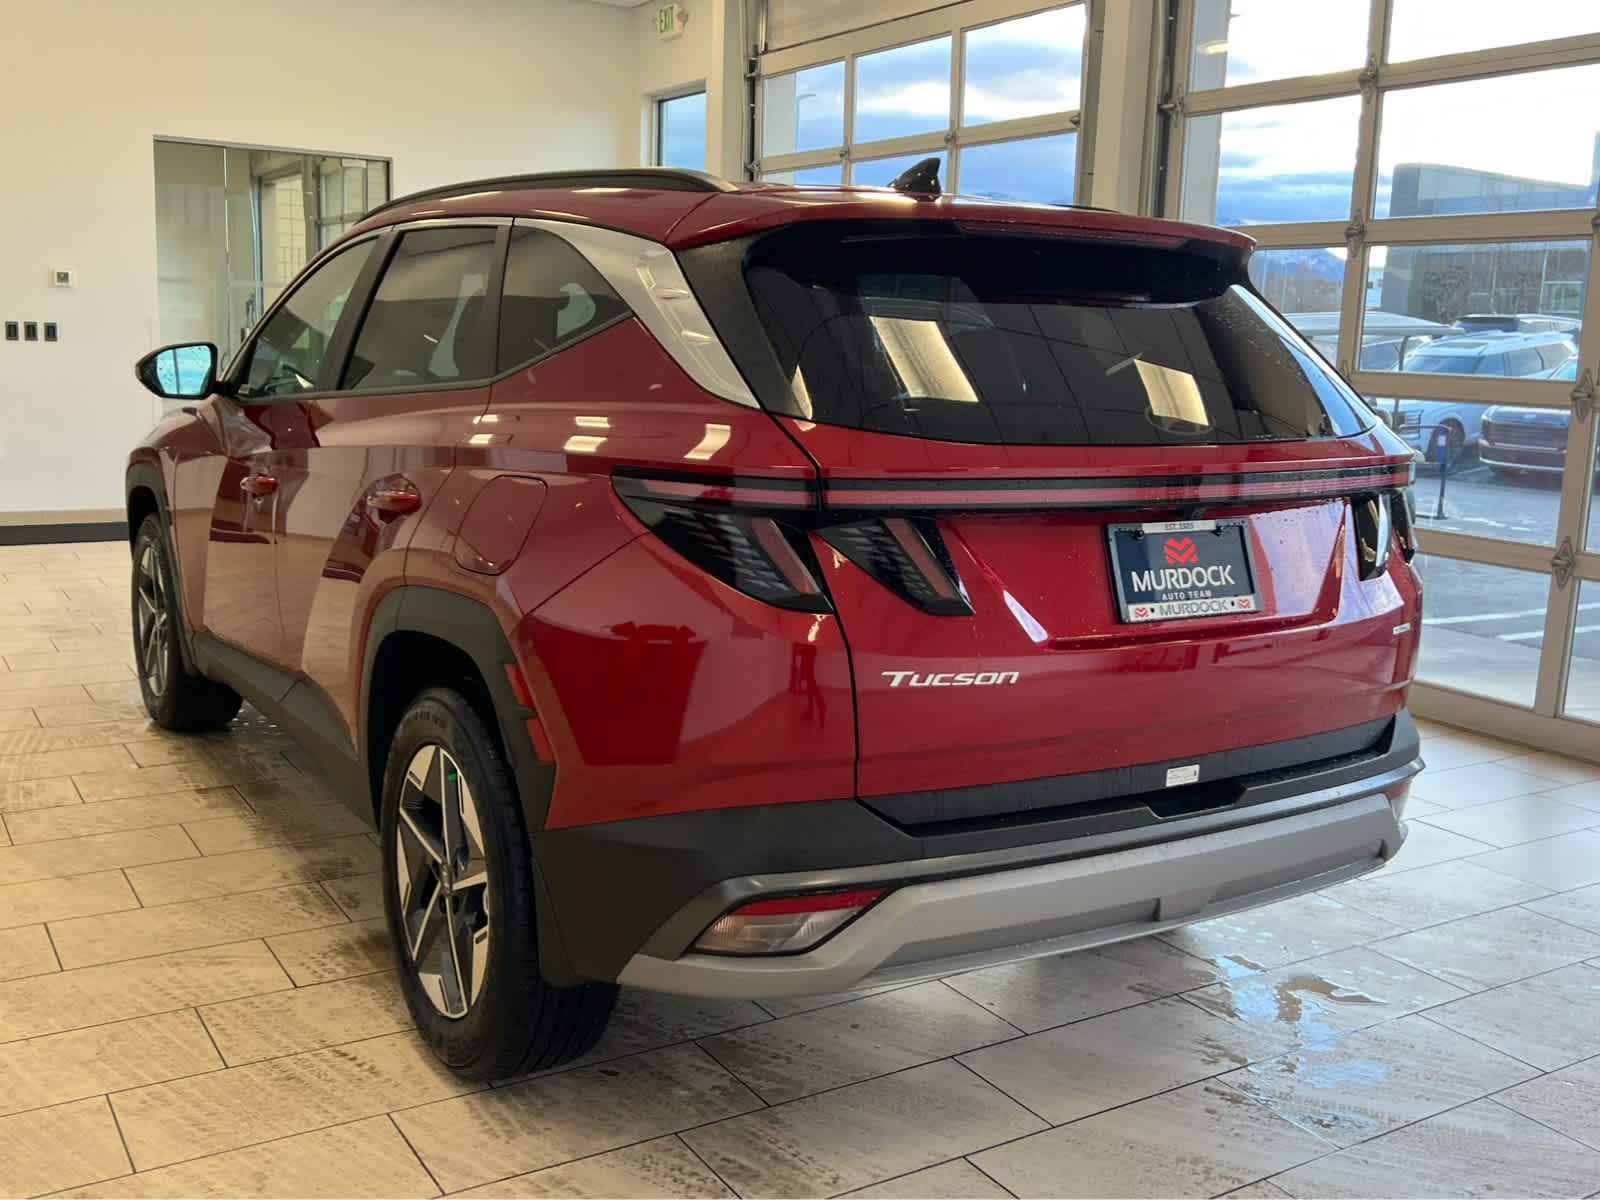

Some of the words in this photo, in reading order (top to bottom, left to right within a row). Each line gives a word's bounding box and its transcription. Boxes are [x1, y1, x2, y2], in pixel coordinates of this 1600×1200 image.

[659, 6, 675, 33] EXIT
[1131, 565, 1236, 592] MURDOCK
[1161, 592, 1185, 601] AUTO
[1189, 590, 1212, 598] TEAM
[1160, 599, 1228, 616] MURDOCK
